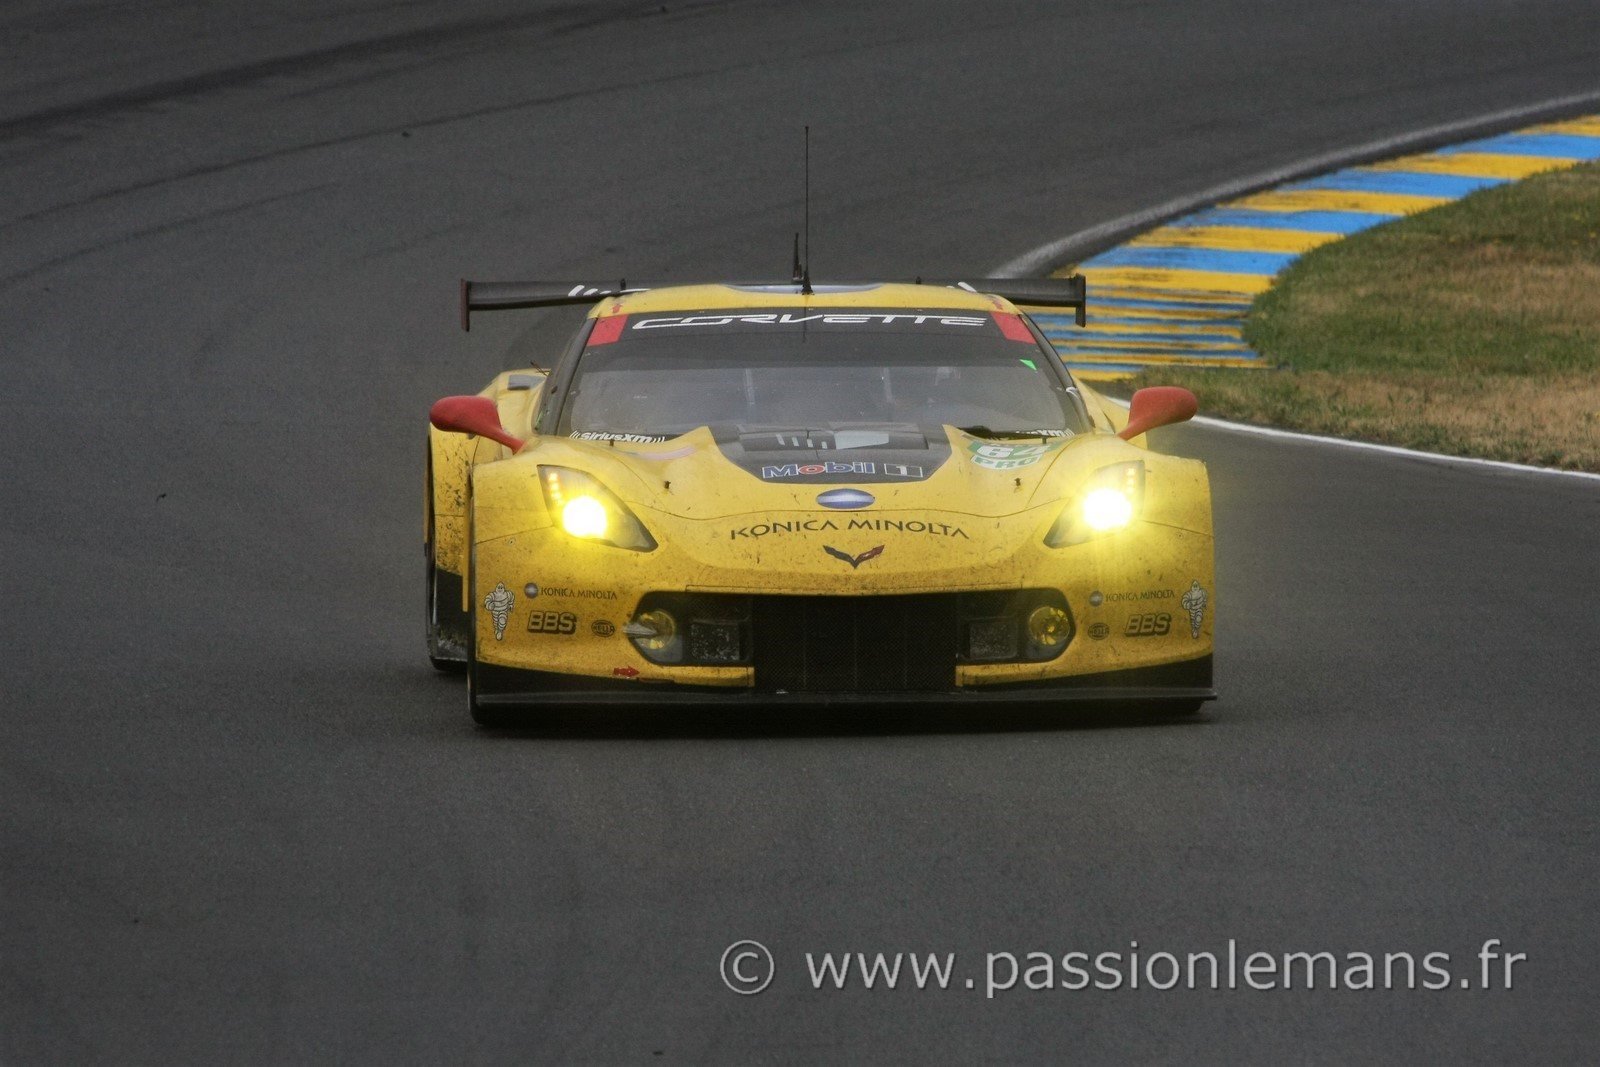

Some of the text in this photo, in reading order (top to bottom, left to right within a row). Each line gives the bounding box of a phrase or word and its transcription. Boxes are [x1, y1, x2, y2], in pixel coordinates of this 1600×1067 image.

[632, 312, 987, 330] CORVETTE
[762, 462, 875, 479] Mobil
[974, 455, 1039, 469] PRO
[731, 519, 970, 540] KONICA MINOLTA
[541, 587, 618, 600] KONICA MINOLTA
[1106, 590, 1175, 602] KONICA MINOLTA
[527, 610, 577, 635] BBS
[1124, 613, 1172, 637] BBS
